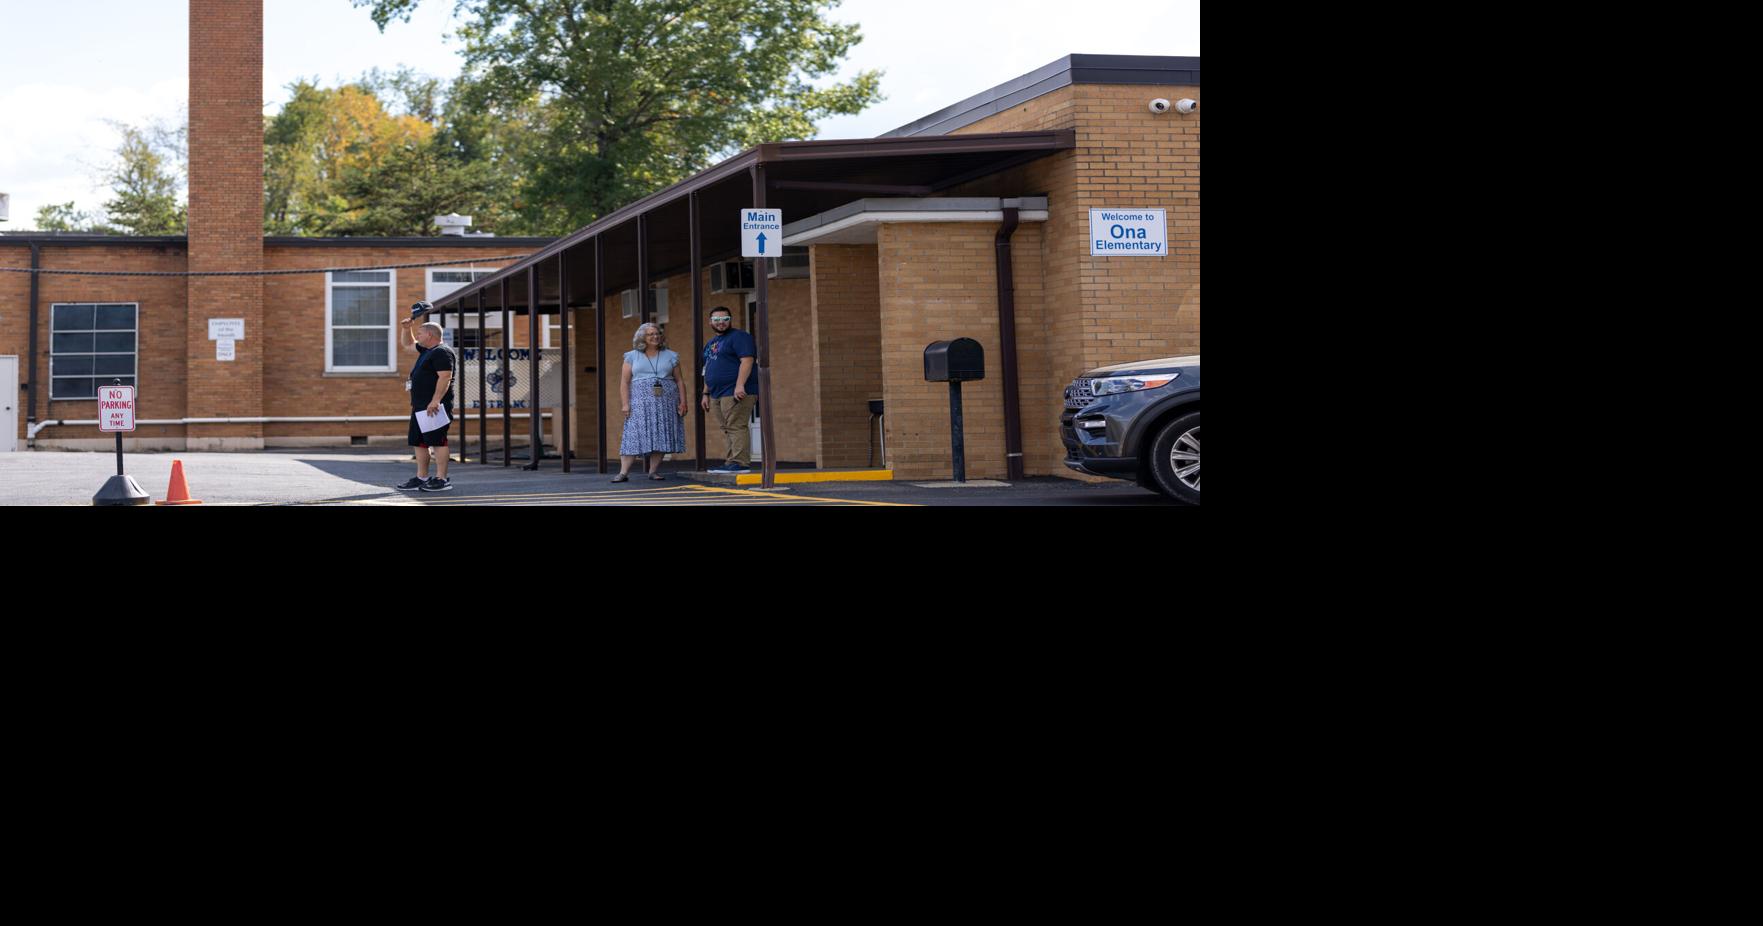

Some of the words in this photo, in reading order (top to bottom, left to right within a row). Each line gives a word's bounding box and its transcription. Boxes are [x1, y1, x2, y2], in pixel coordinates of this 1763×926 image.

[747, 211, 775, 221] Main
[1101, 213, 1143, 221] Welcome
[1145, 213, 1154, 221] to
[743, 222, 780, 230] Entrance
[1110, 224, 1147, 239] Ona
[1096, 240, 1161, 252] Elementary
[109, 390, 122, 399] NO
[101, 401, 132, 409] PARKING
